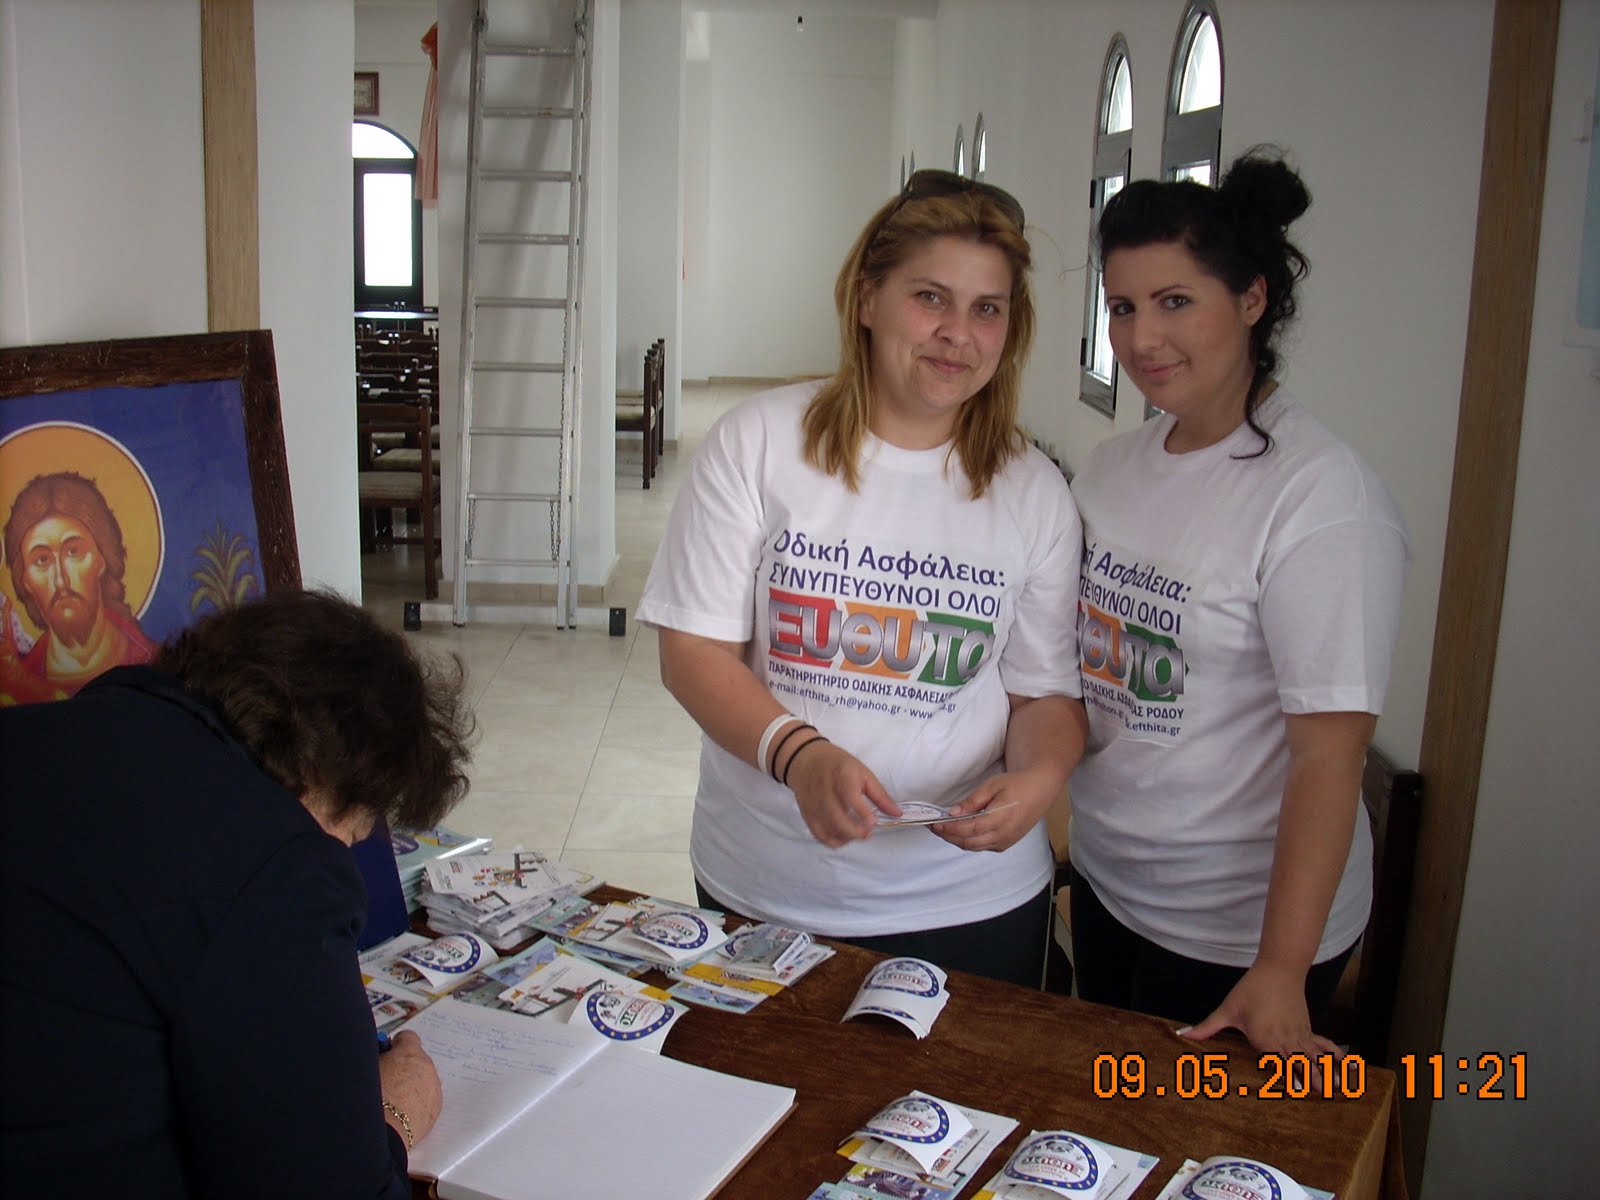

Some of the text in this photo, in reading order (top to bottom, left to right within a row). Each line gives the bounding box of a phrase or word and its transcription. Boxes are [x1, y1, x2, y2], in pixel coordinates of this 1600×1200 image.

[857, 546, 1006, 587] Ασφάλεια:
[768, 562, 1001, 619] ΣΥΝΥΠΕΥΘΥΝΟΙ ΟΛΟΙ
[1137, 602, 1181, 635] ΟΛΟΙ
[768, 660, 850, 690] ΠΑΡΑΤΗΡΗΤΗΡΙΟ
[852, 680, 892, 696] ΟΔΙΚΗΣ
[1146, 707, 1185, 720] ΡΟΔΟΥ
